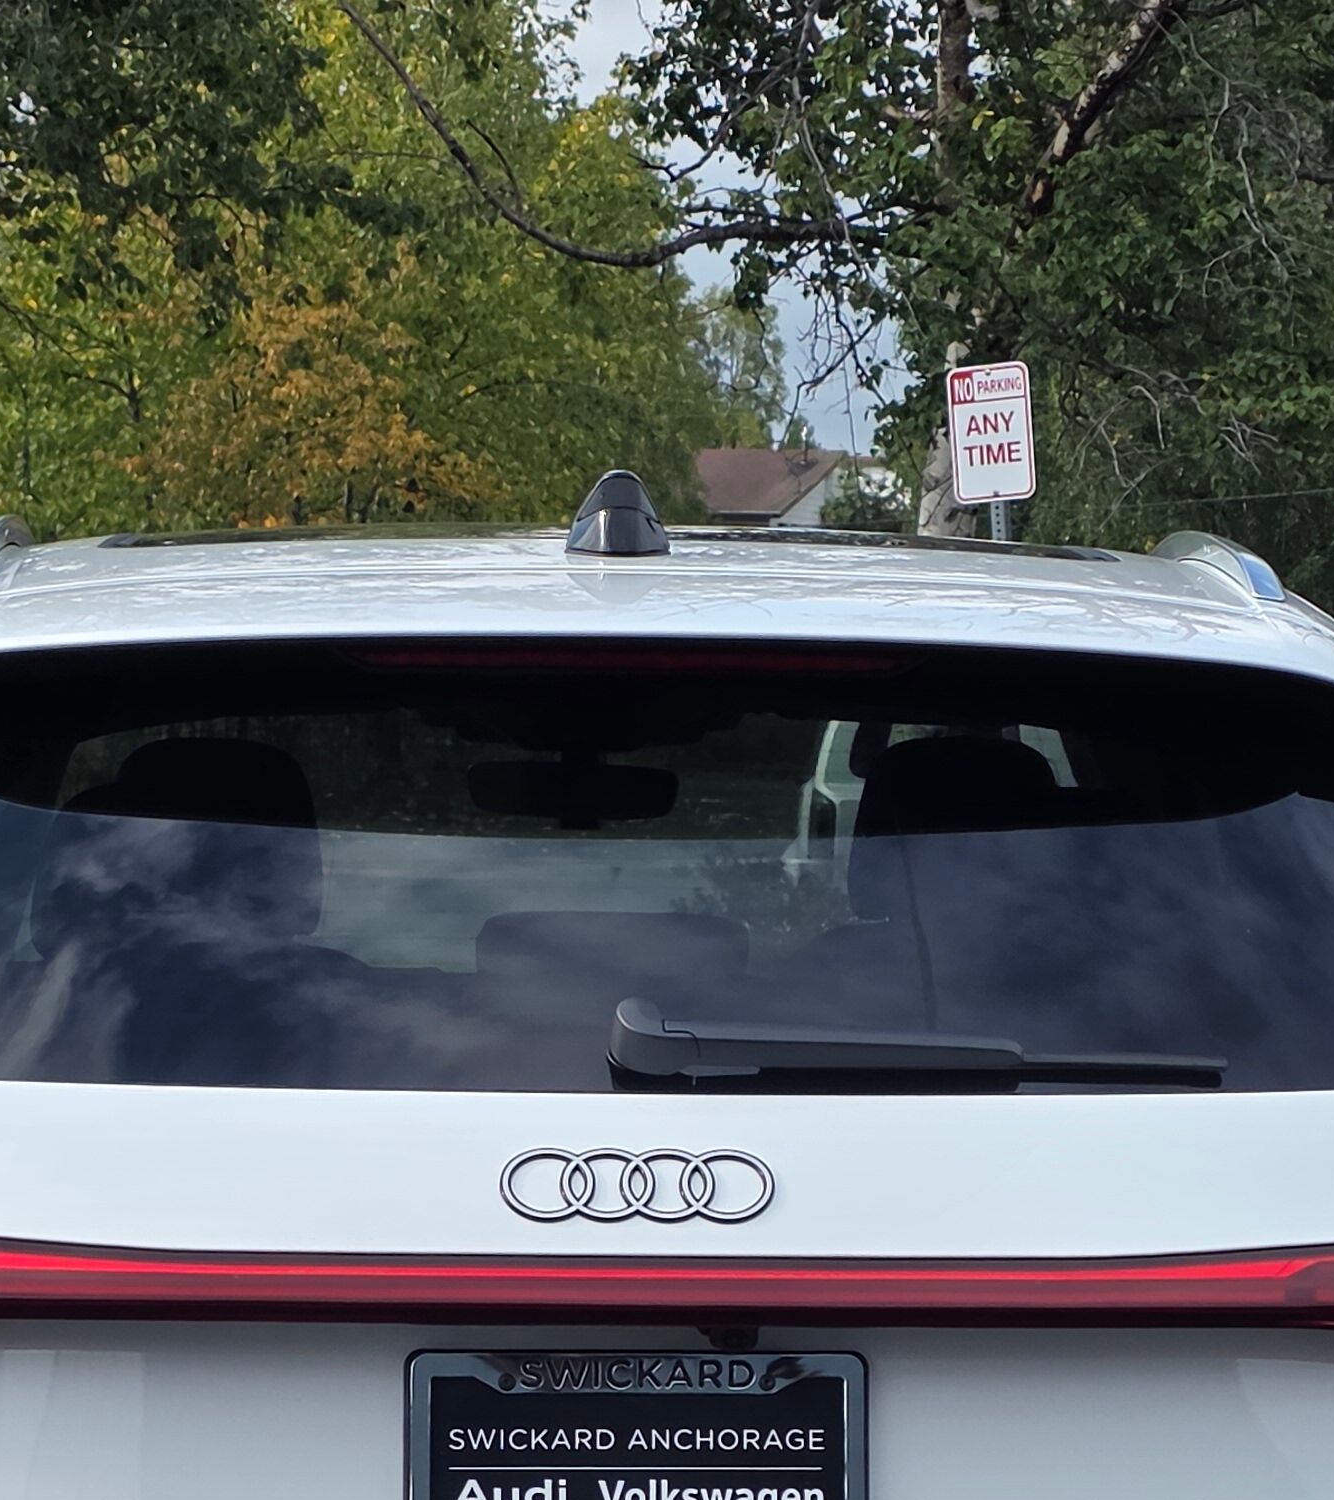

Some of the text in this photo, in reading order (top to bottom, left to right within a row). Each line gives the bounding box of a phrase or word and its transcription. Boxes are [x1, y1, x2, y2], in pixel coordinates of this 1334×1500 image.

[953, 376, 1022, 402] NO PARKING
[966, 411, 1014, 437] ANY
[963, 441, 1022, 467] TIME
[519, 1359, 757, 1391] SWICKARD
[448, 1428, 826, 1451] SWICKARD ANCHORAGE
